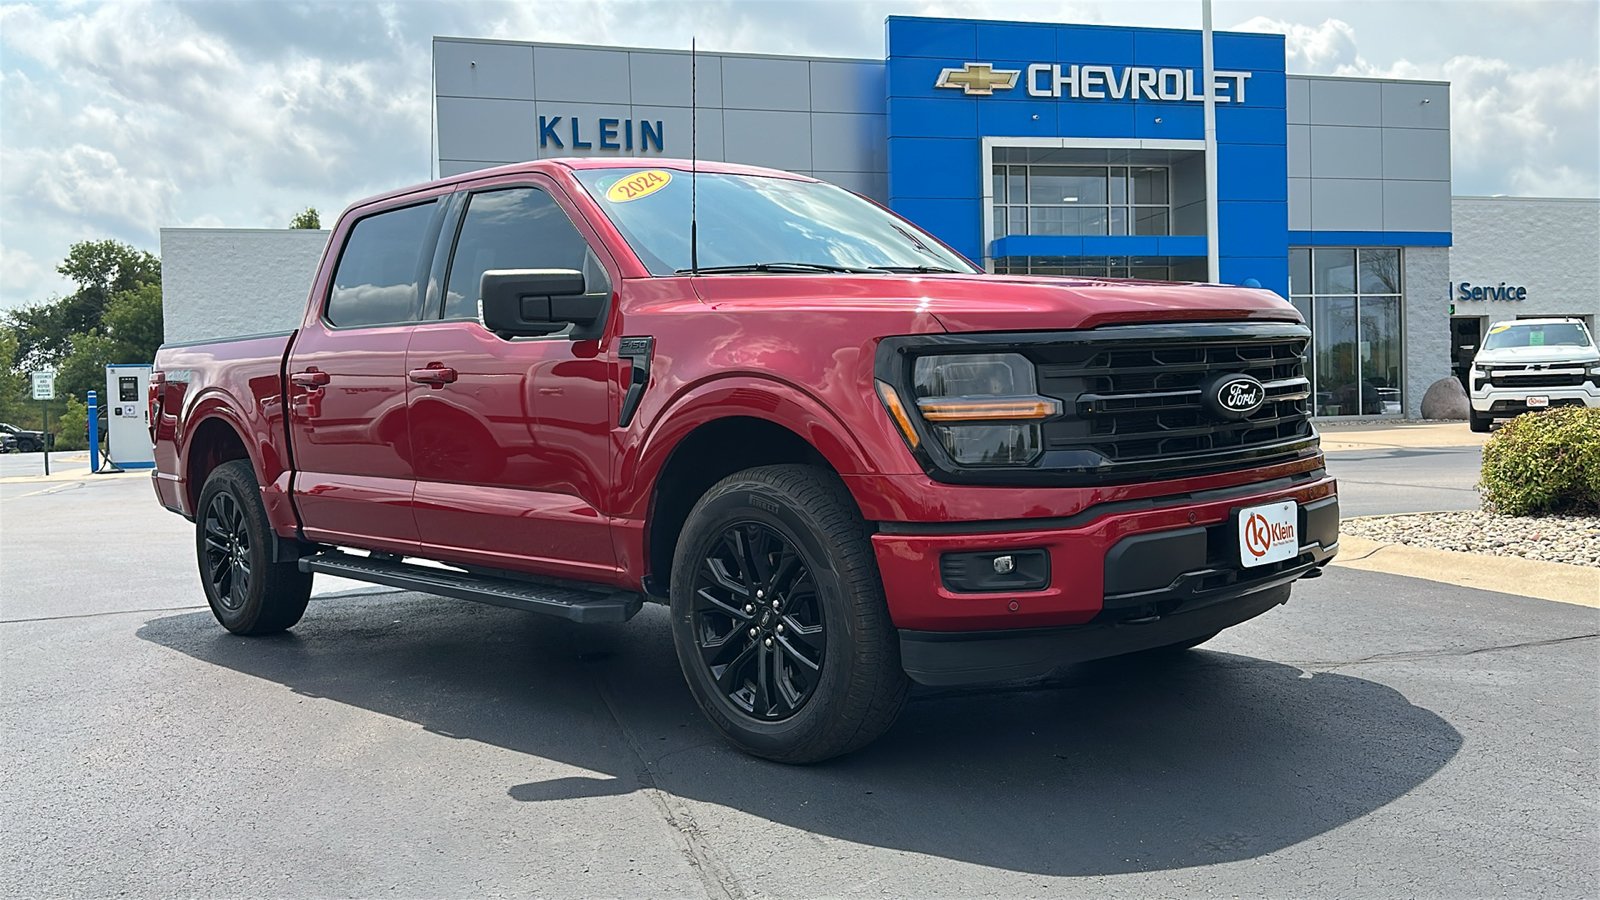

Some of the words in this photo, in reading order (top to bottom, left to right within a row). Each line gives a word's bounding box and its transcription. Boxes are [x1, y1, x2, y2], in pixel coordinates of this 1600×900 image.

[1027, 63, 1252, 103] CHEVROLET
[539, 115, 664, 152] KLEIN
[618, 172, 664, 198] 2024
[1459, 282, 1527, 301] Service
[1228, 384, 1256, 407] Ford
[749, 493, 780, 514] PIRELLI
[1271, 521, 1295, 541] Klein
